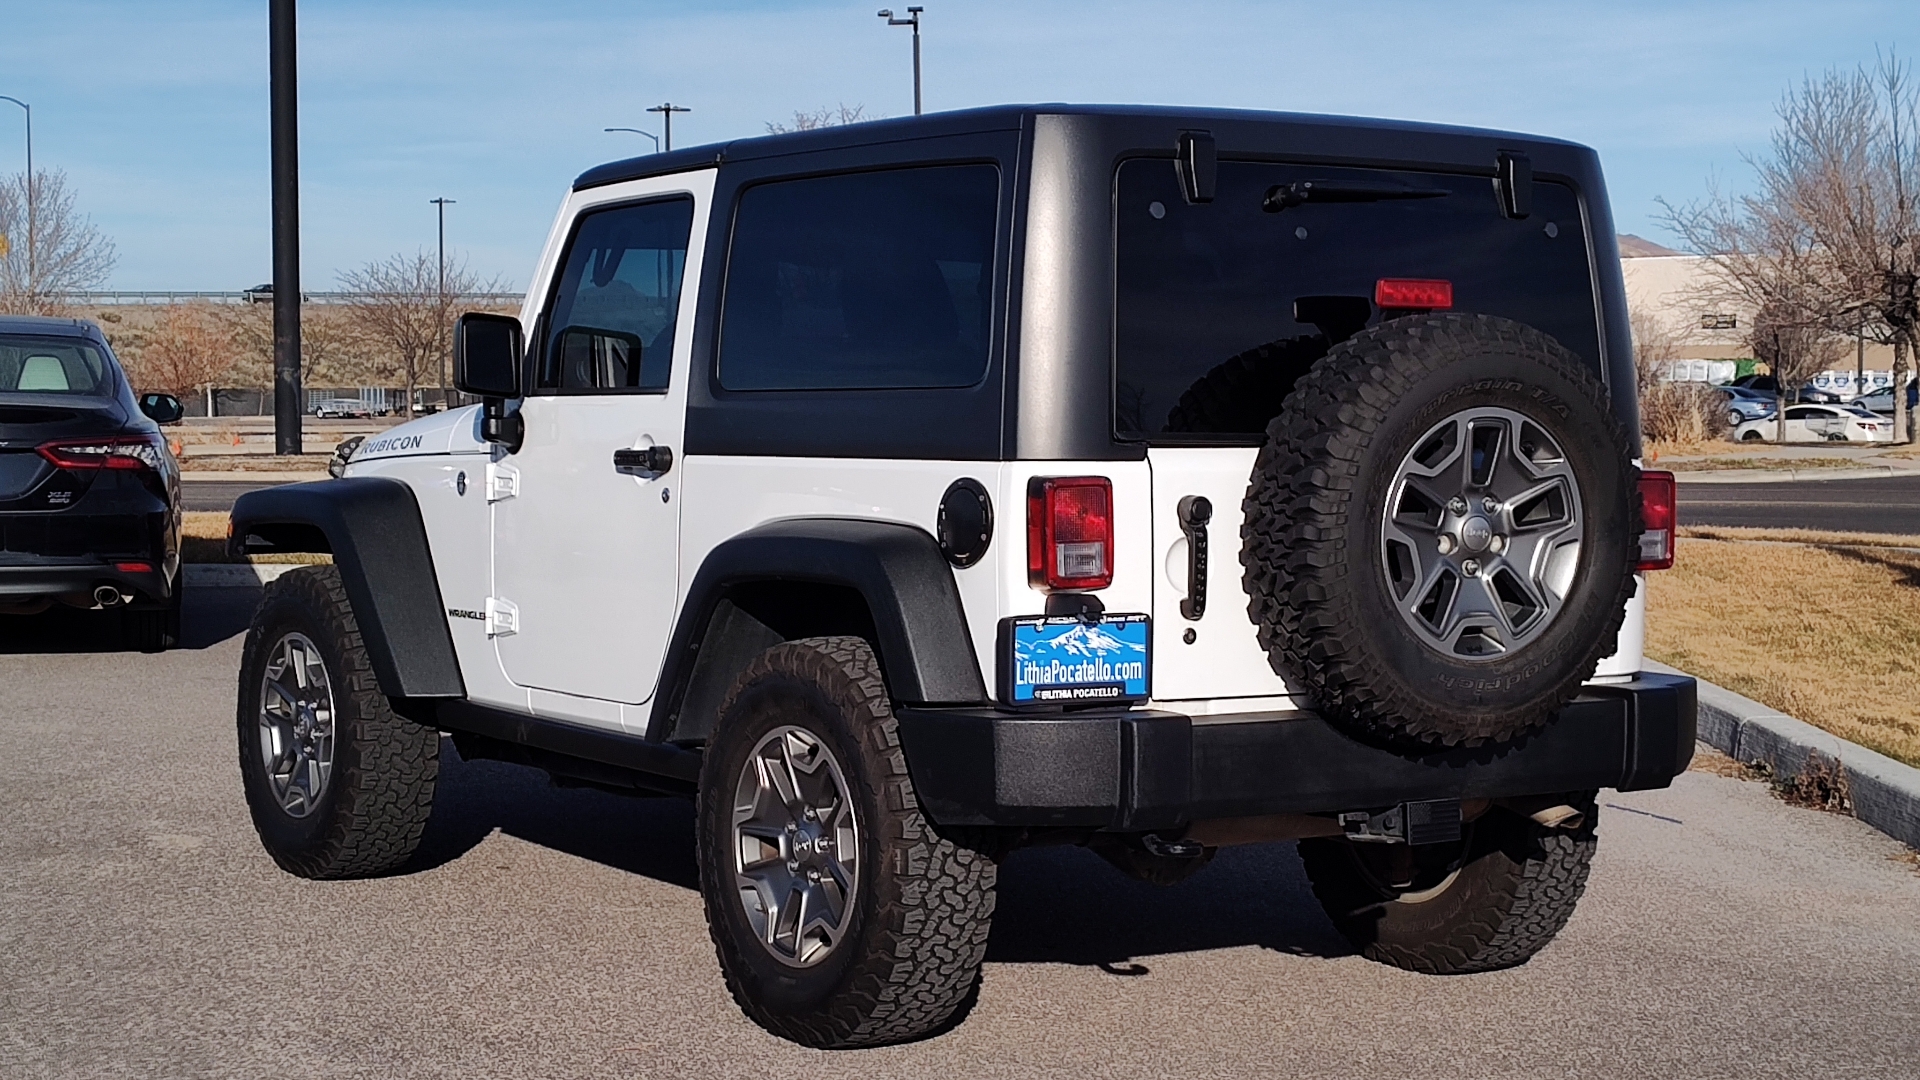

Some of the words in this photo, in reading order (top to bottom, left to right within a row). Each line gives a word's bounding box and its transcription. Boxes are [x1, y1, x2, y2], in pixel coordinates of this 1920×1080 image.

[360, 435, 423, 454] RUBICON
[448, 609, 486, 621] WRANGLE
[1016, 657, 1143, 685] LithiaPocatello.com
[1048, 689, 1072, 700] LITHIA
[1073, 687, 1119, 699] POCATELLO
